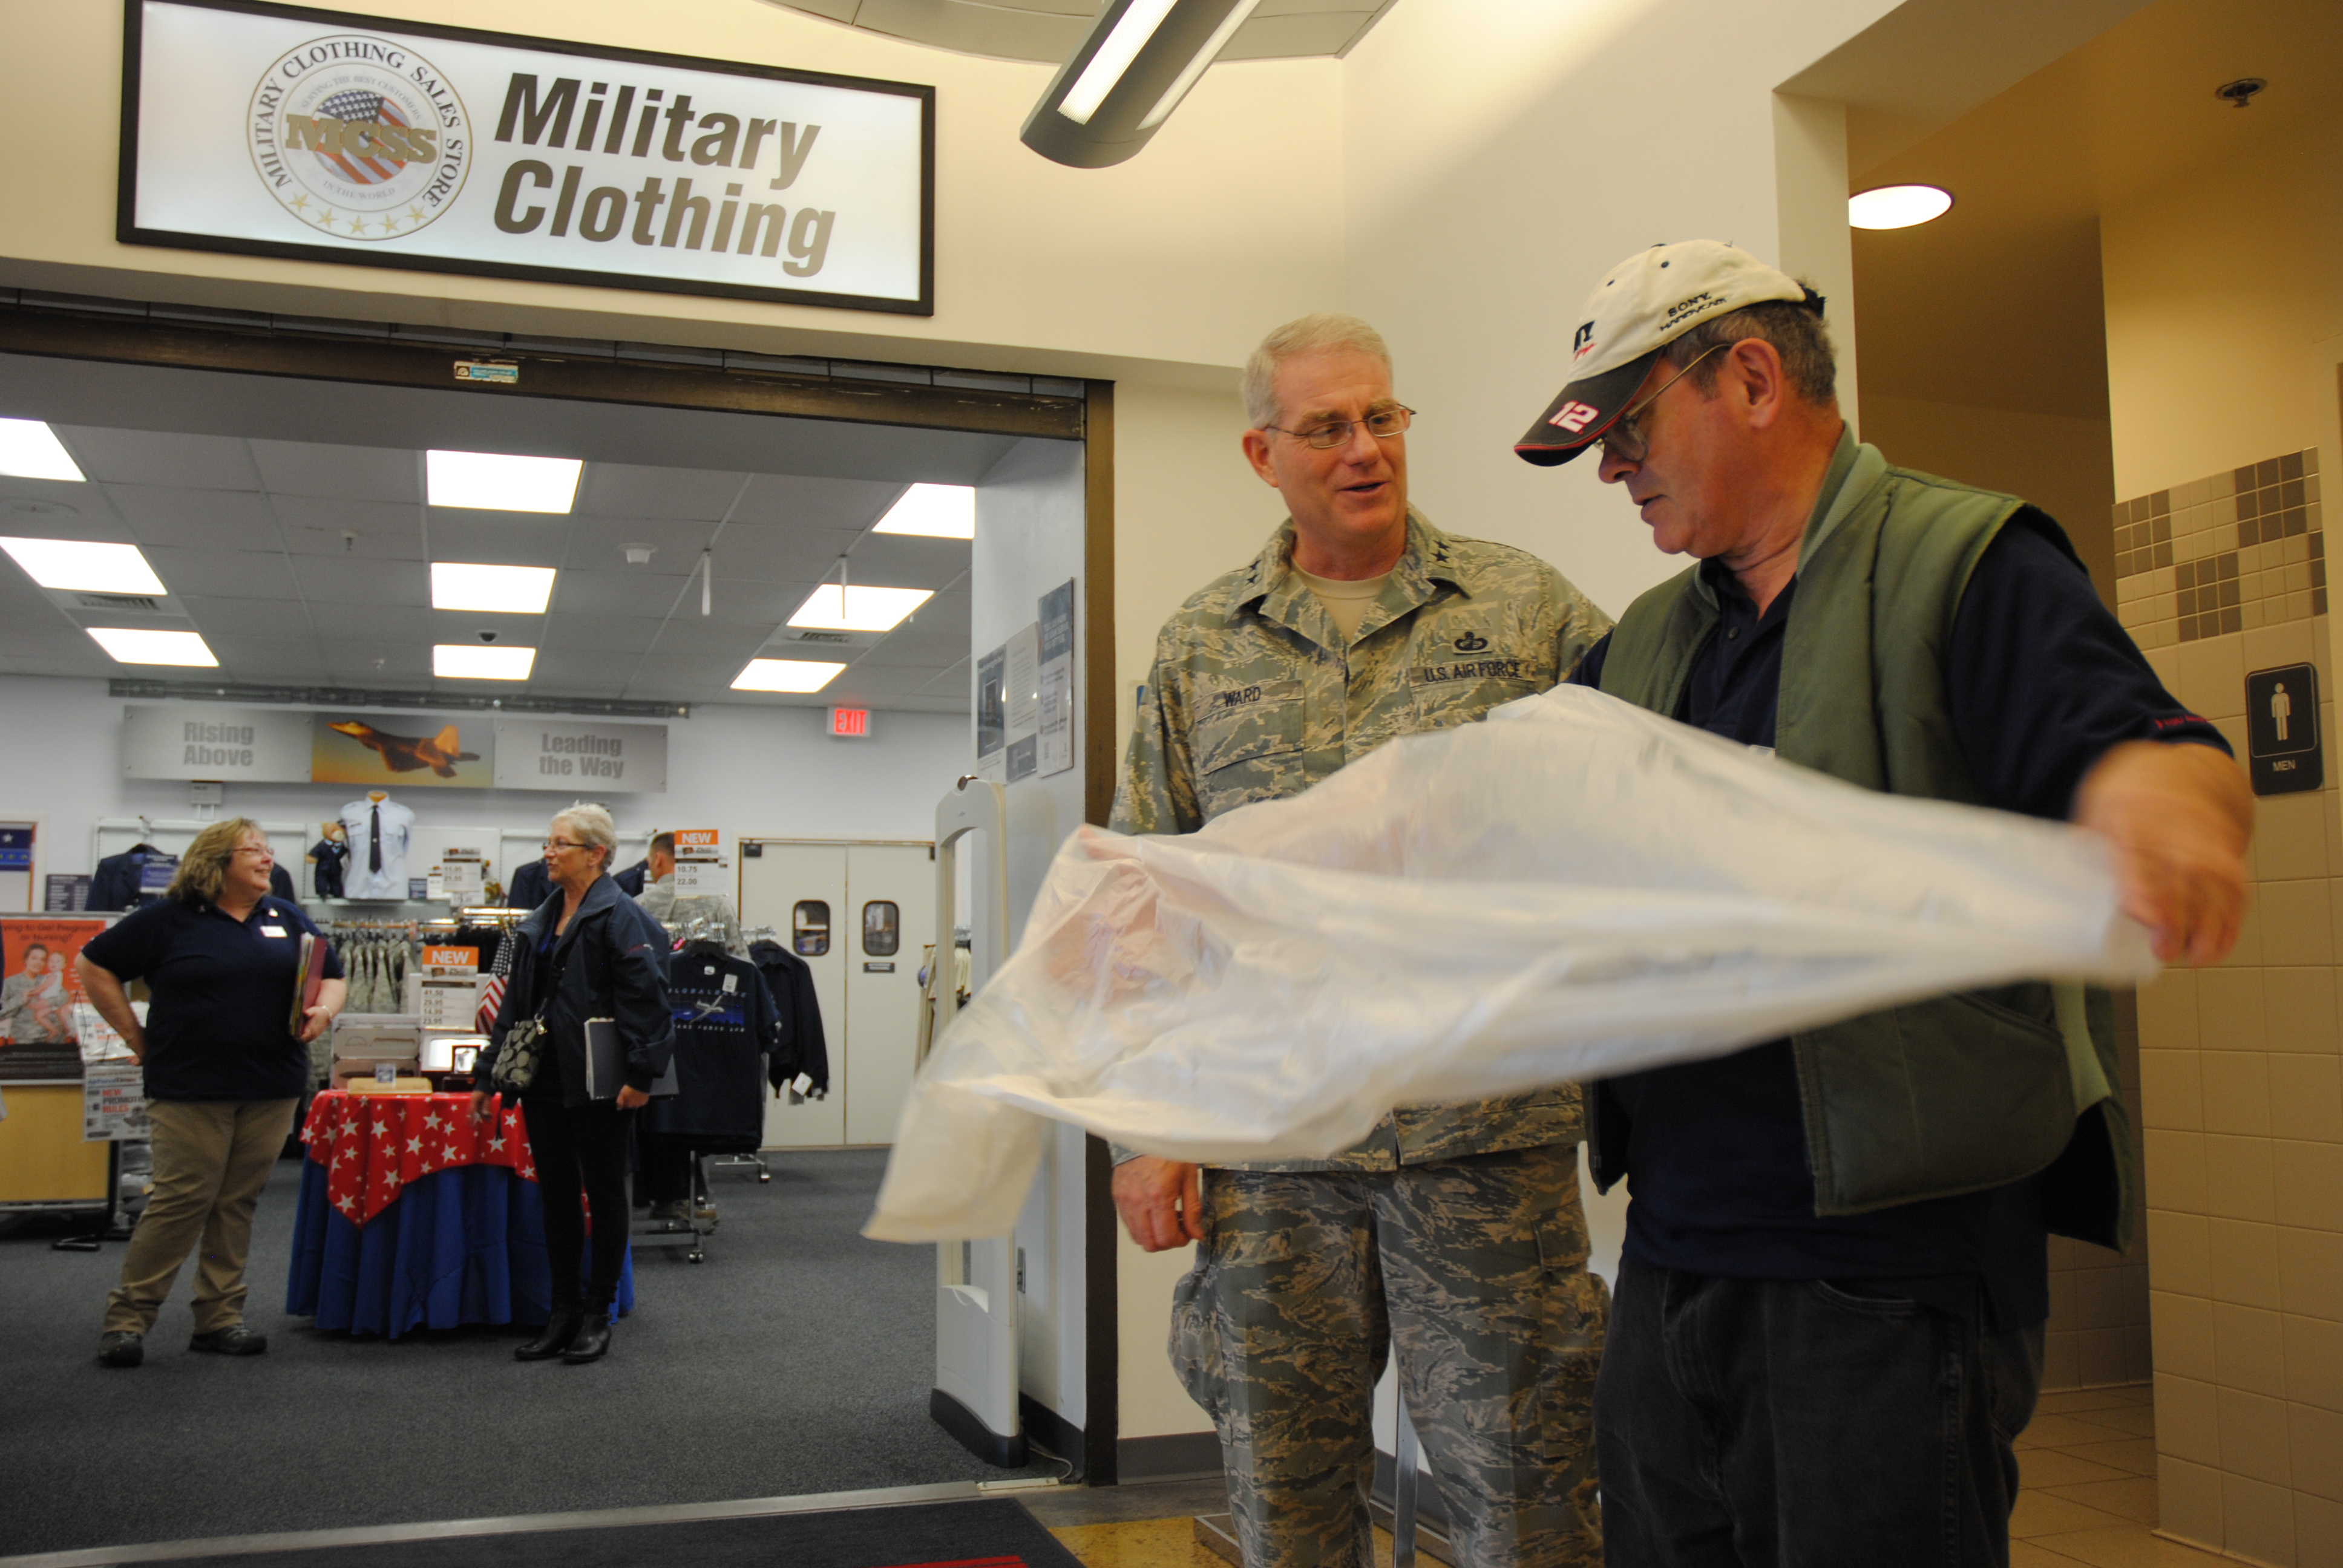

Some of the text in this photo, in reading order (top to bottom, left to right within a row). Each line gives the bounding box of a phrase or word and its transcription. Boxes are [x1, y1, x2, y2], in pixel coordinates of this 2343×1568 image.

[332, 76, 352, 86] THE
[353, 76, 376, 85] BEST
[378, 80, 423, 121] CUSTOMERS
[255, 41, 464, 207] MILITARY CLOTHING SALES STORE
[493, 71, 822, 191] Military
[285, 113, 437, 164] MCSS
[335, 187, 356, 199] THE
[358, 187, 396, 200] WORLD
[493, 159, 836, 278] Clothing
[1668, 292, 1711, 317] SONY
[1547, 400, 1599, 434] 12
[1425, 661, 1522, 682] U.S. AIR FORCE
[1224, 687, 1261, 708] WARD
[184, 721, 255, 745] Rising
[834, 709, 867, 734] EXIT
[183, 745, 254, 766] Above
[542, 733, 623, 757] Leading
[539, 756, 624, 779] the Way
[2273, 760, 2296, 771] MEN
[682, 832, 712, 844] NEW
[431, 950, 470, 965] NEW
[102, 1104, 129, 1113] RULES
